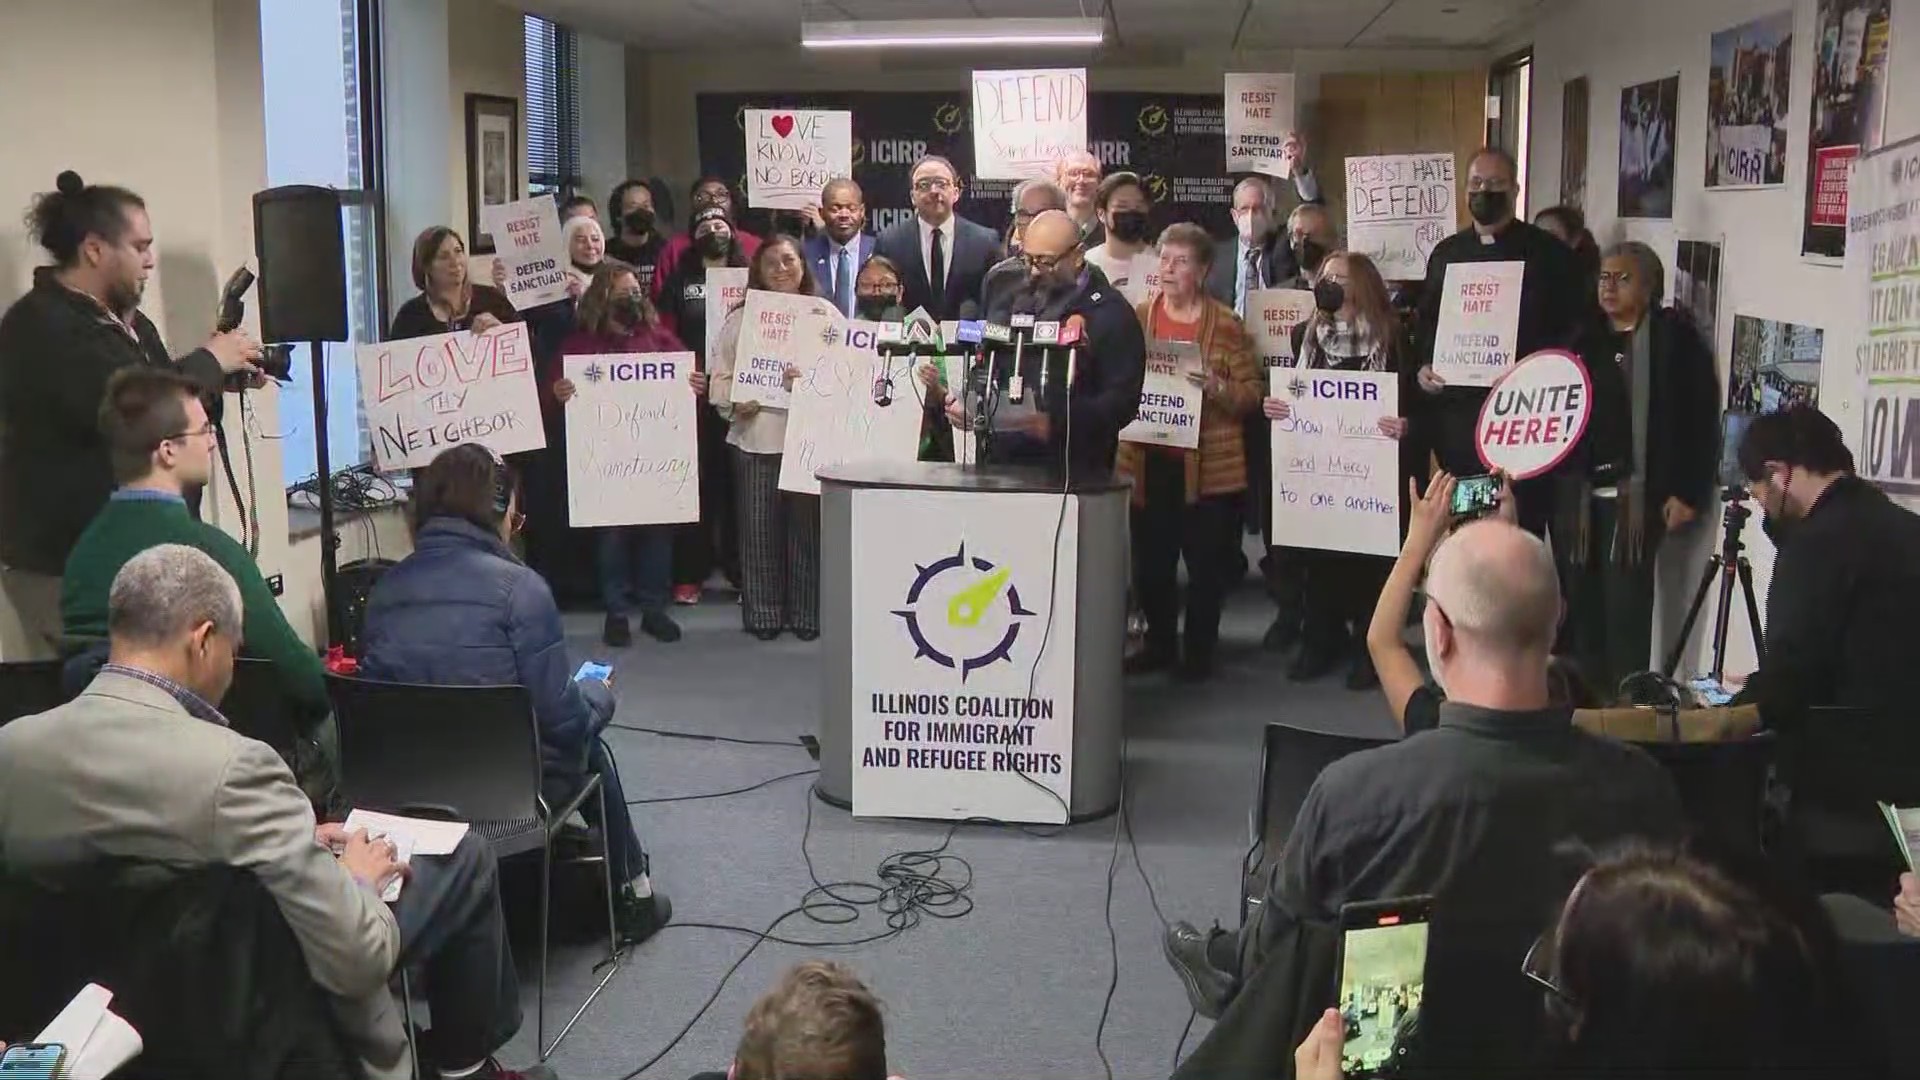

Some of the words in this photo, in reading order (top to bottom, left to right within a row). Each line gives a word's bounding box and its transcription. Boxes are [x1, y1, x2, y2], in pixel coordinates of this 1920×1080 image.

[975, 73, 1085, 128] DEFEND
[1241, 92, 1277, 104] RESIST
[1245, 107, 1272, 119] HATE
[1240, 134, 1280, 146] DEFEND
[757, 141, 827, 165] KNOWS
[755, 166, 782, 185] NO
[1413, 159, 1453, 181] HATE
[1354, 185, 1450, 216] DEFEND
[506, 217, 541, 234] RESIST
[513, 232, 541, 247] HATE
[516, 258, 556, 276] DEFEND
[510, 271, 568, 293] SANCTUARY
[1460, 283, 1500, 296] RESIST
[1264, 309, 1300, 321] RESIST
[1463, 300, 1493, 313] HATE
[760, 310, 797, 326] RESIST
[762, 328, 790, 341] HATE
[846, 329, 877, 350] ICI
[1454, 334, 1500, 347] DEFEND
[378, 328, 528, 403] LOVE
[1440, 352, 1511, 365] SANCTUARY
[611, 363, 676, 381] ICIRR
[1147, 364, 1176, 376] HATE
[425, 387, 469, 410] THY
[1313, 380, 1378, 401] ICIRR
[1494, 384, 1583, 416] UNITE
[1140, 393, 1185, 409] DEFEND
[378, 412, 527, 459] NEIGHBOR
[1484, 415, 1574, 446] HERE!
[1289, 454, 1315, 470] and
[1328, 455, 1370, 480] Mercy
[1280, 481, 1298, 503] to
[1310, 492, 1336, 506] one
[1345, 496, 1393, 514] another
[872, 693, 948, 716] ILLINOIS
[955, 696, 1053, 720] COALITION
[884, 721, 920, 742] FOR
[927, 722, 1035, 746] IMMIGRANT
[862, 748, 900, 768] AND
[907, 749, 987, 772] REFUGEE
[992, 753, 1062, 775] RIGHTS
